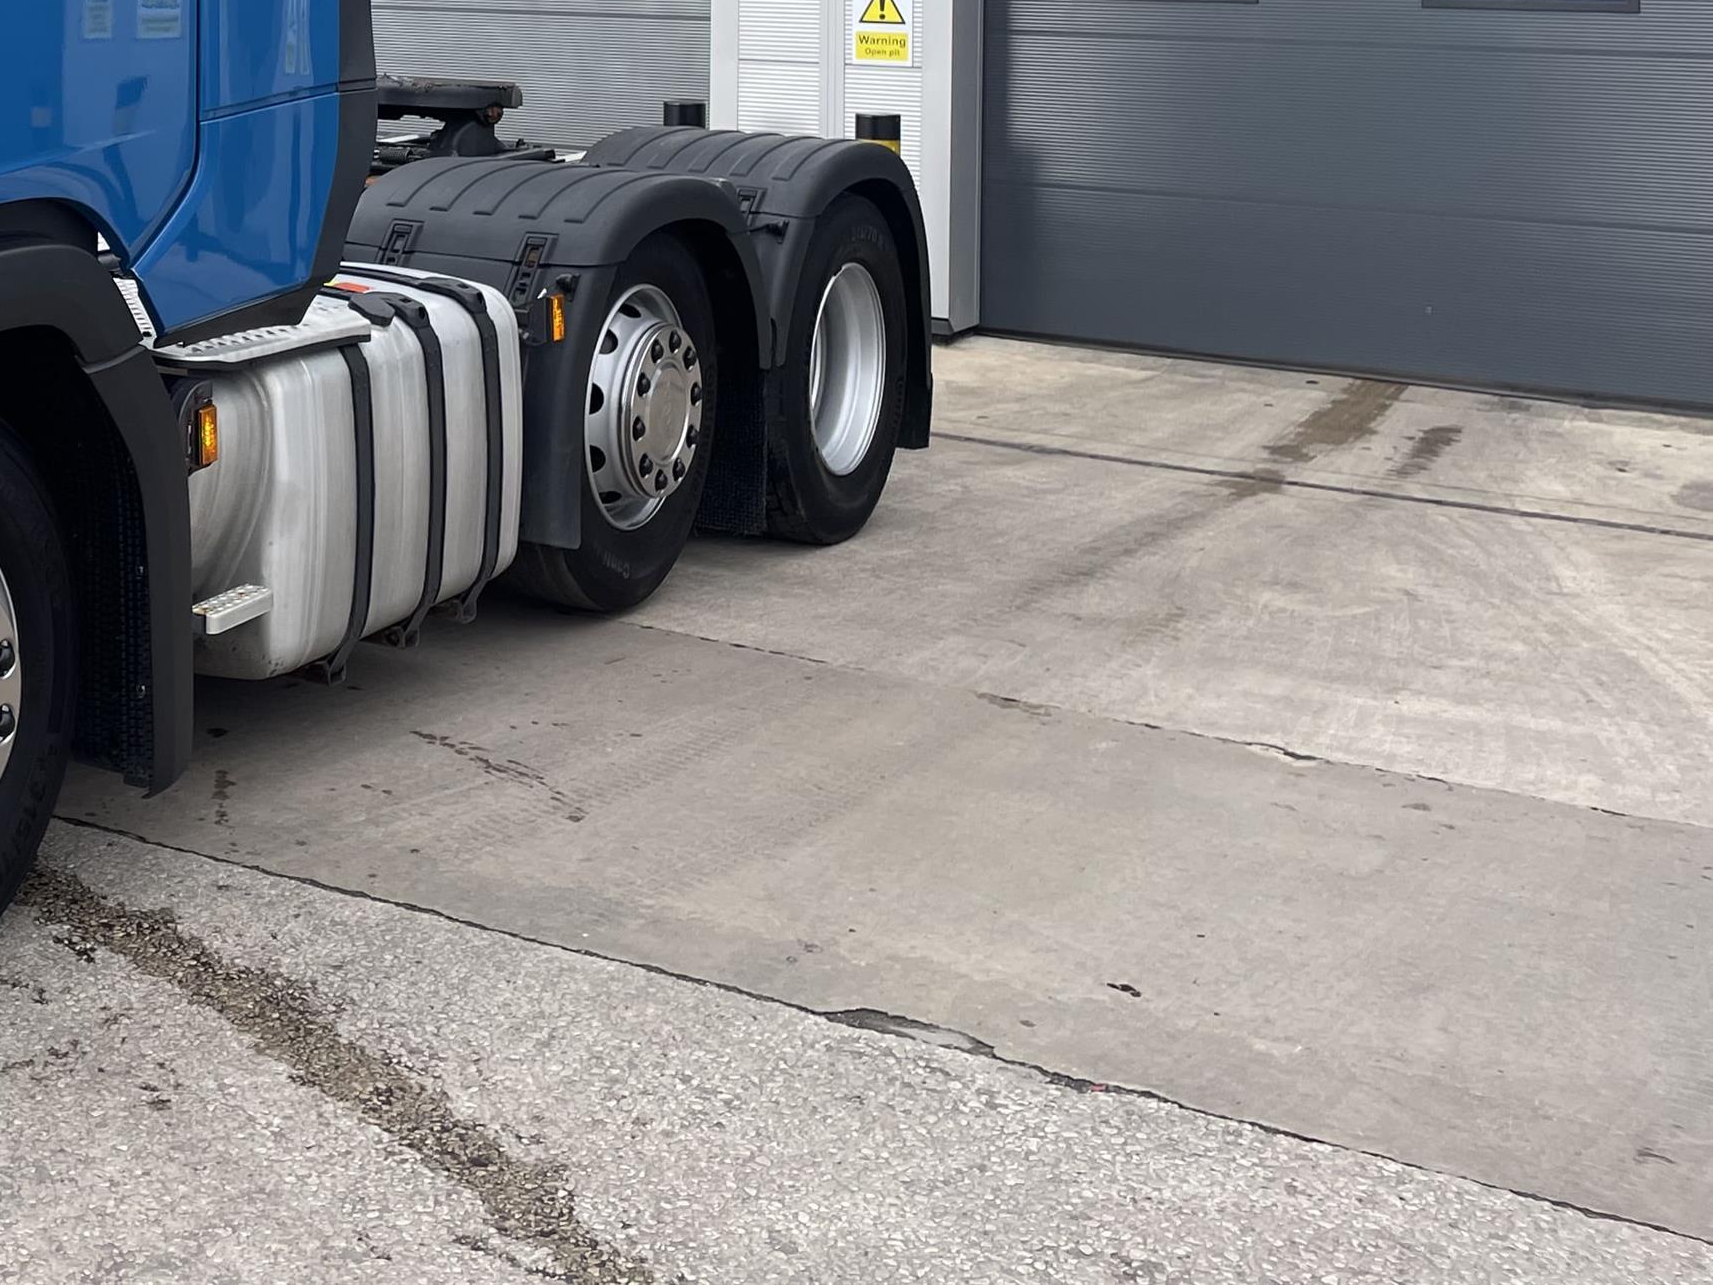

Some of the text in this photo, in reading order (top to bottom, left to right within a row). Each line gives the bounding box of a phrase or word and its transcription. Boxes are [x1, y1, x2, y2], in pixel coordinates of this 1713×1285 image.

[858, 34, 906, 48] Warning
[865, 48, 900, 57] Open pit
